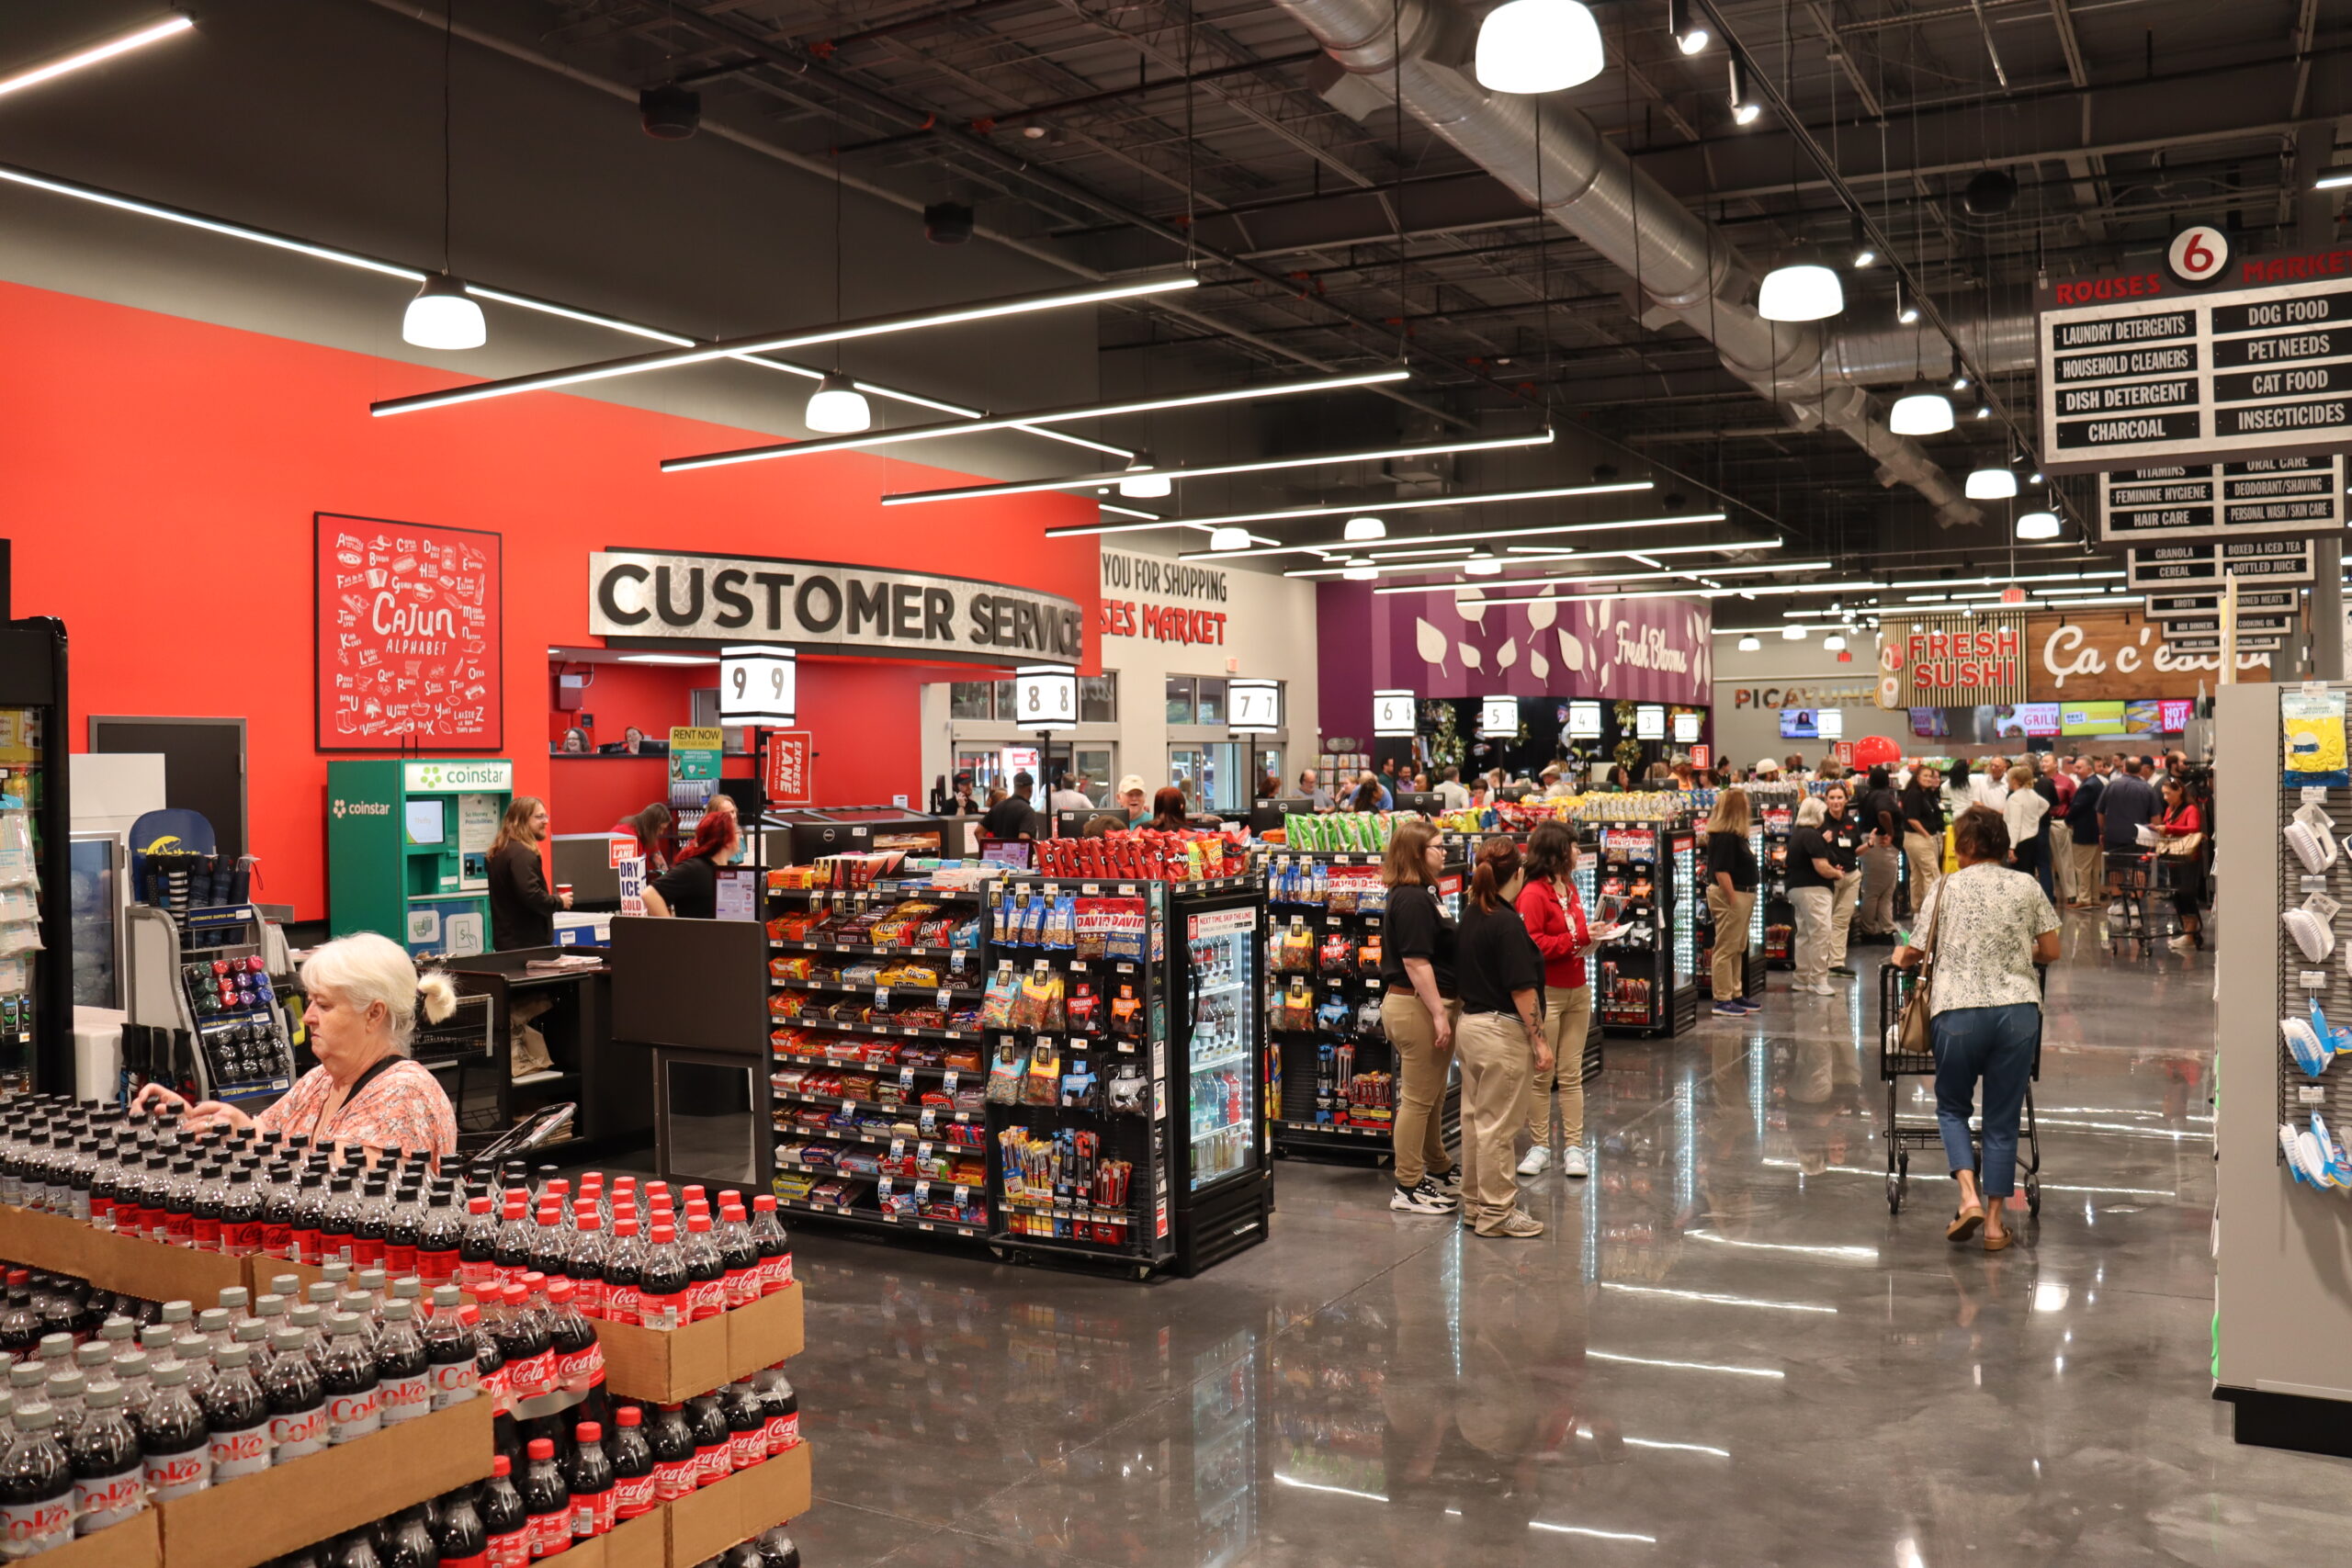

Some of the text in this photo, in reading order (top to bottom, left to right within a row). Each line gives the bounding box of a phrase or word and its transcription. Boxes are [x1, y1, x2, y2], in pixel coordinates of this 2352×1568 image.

[2183, 233, 2214, 273] 6
[2056, 274, 2162, 305] ROUSES
[2248, 299, 2330, 326] DOG FOOD
[2063, 315, 2187, 346] LAUNDRY DETERGENTS
[2248, 334, 2331, 361] PET NEEDS
[2063, 349, 2188, 378] HOUSEHOLD CLEANERS
[2252, 369, 2330, 395] CAT FOOD
[2065, 382, 2188, 412] DISH DETERGENT
[2238, 403, 2346, 431] INSECTICIDES
[2087, 419, 2166, 443] CHARCOAL
[2136, 466, 2186, 479] VITAMINS
[2247, 457, 2309, 471] ORAL CARE
[2116, 485, 2207, 504] FEMININE HYGIENE
[2234, 478, 2323, 497] DEODORANT/SHAVING
[2133, 511, 2190, 527] HAIR CARE
[2231, 506, 2265, 522] PERSONAL
[2309, 502, 2327, 516] CARE
[2154, 547, 2194, 559] GRANOLA
[2228, 541, 2301, 556] BOXED & ICED TEA
[1102, 552, 1227, 603] YOU FOR SHOPPING
[2159, 566, 2190, 578] CEREAL
[2233, 560, 2297, 574] BOTTLED JUICE
[2173, 599, 2196, 608] BROTH
[2237, 593, 2284, 606] ANNED MEATS
[597, 563, 1082, 659] CUSTOMER SERVICE
[1142, 603, 1227, 647] MARKET
[2238, 620, 2265, 628] COOKING
[386, 638, 447, 656] ALPHABET
[1614, 620, 1689, 675] Fresh Blooms
[2043, 625, 2106, 688] Ça
[1908, 629, 2018, 690] FRESH SUSHI
[732, 666, 747, 700] 9
[771, 667, 785, 700] 9
[1028, 685, 1041, 712] 8
[1059, 685, 1069, 712] 8
[1240, 695, 1250, 717] 7
[1266, 696, 1272, 717] 7
[1735, 687, 1875, 710] PICAYUNE
[1384, 702, 1393, 720] 6
[1492, 708, 1499, 725] 5
[1578, 715, 1585, 727] 4
[2024, 714, 2058, 726] GRILL
[2164, 706, 2188, 717] HOT
[1645, 716, 1651, 729] 3
[673, 729, 720, 740] RENT NOW
[447, 766, 503, 784] coinstar
[780, 740, 794, 794] LANE
[793, 740, 802, 795] EXPRESS
[348, 800, 390, 817] coinstar
[613, 850, 634, 859] LANE
[619, 862, 639, 878] DRY
[621, 881, 640, 897] ICE
[622, 900, 641, 911] SOLD
[1112, 915, 1145, 928] DAVID
[380, 1382, 426, 1406] oke
[209, 1435, 264, 1461] oke
[143, 1458, 202, 1487] oke
[74, 1483, 140, 1514] oke
[0, 1509, 69, 1543] oke
